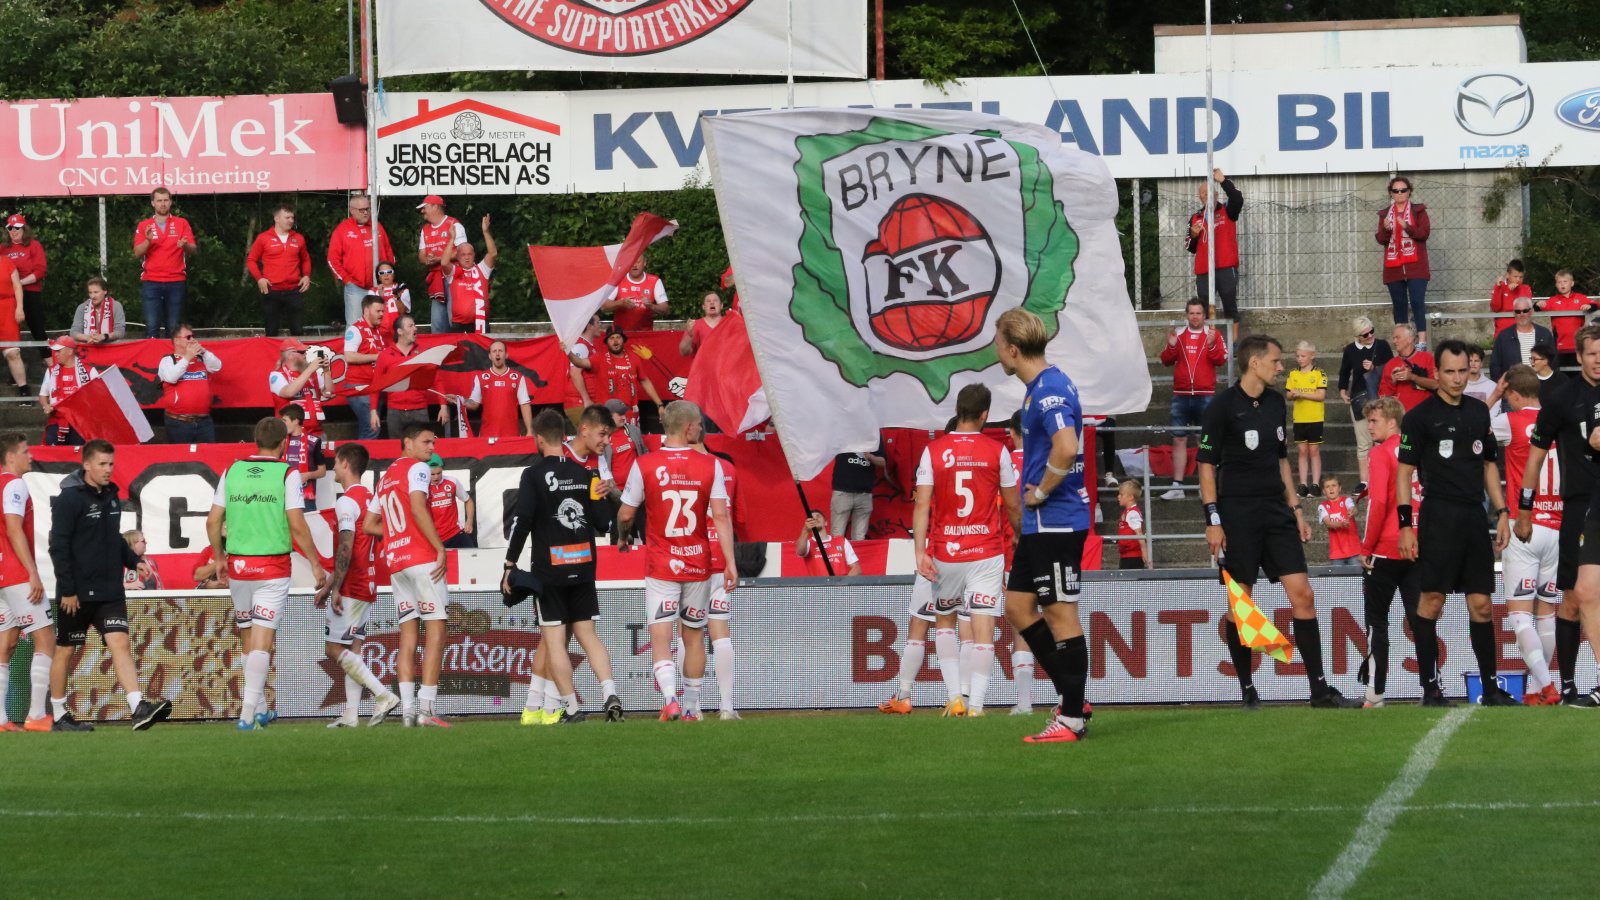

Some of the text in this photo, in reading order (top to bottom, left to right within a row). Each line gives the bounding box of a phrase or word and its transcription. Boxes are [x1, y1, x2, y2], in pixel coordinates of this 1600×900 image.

[546, 0, 740, 51] SUPPORTERKLU
[10, 98, 316, 160] UniMek
[420, 132, 447, 140] BYGG
[488, 131, 526, 139] MESTER
[1278, 91, 1424, 151] BIL
[386, 142, 551, 164] JENS GERLACH
[59, 166, 271, 189] CNC Maskinering
[388, 165, 510, 186] SØRENSEN
[838, 137, 1011, 212] BRYNE
[884, 244, 970, 301] FK
[1540, 447, 1560, 495] 11
[955, 471, 974, 517] 5
[379, 490, 407, 538] 10
[661, 489, 698, 538] 23
[255, 604, 276, 620] ECS
[664, 600, 677, 611] EC
[688, 606, 706, 619] ECS
[712, 599, 731, 611] ECS
[975, 593, 997, 607] ECS
